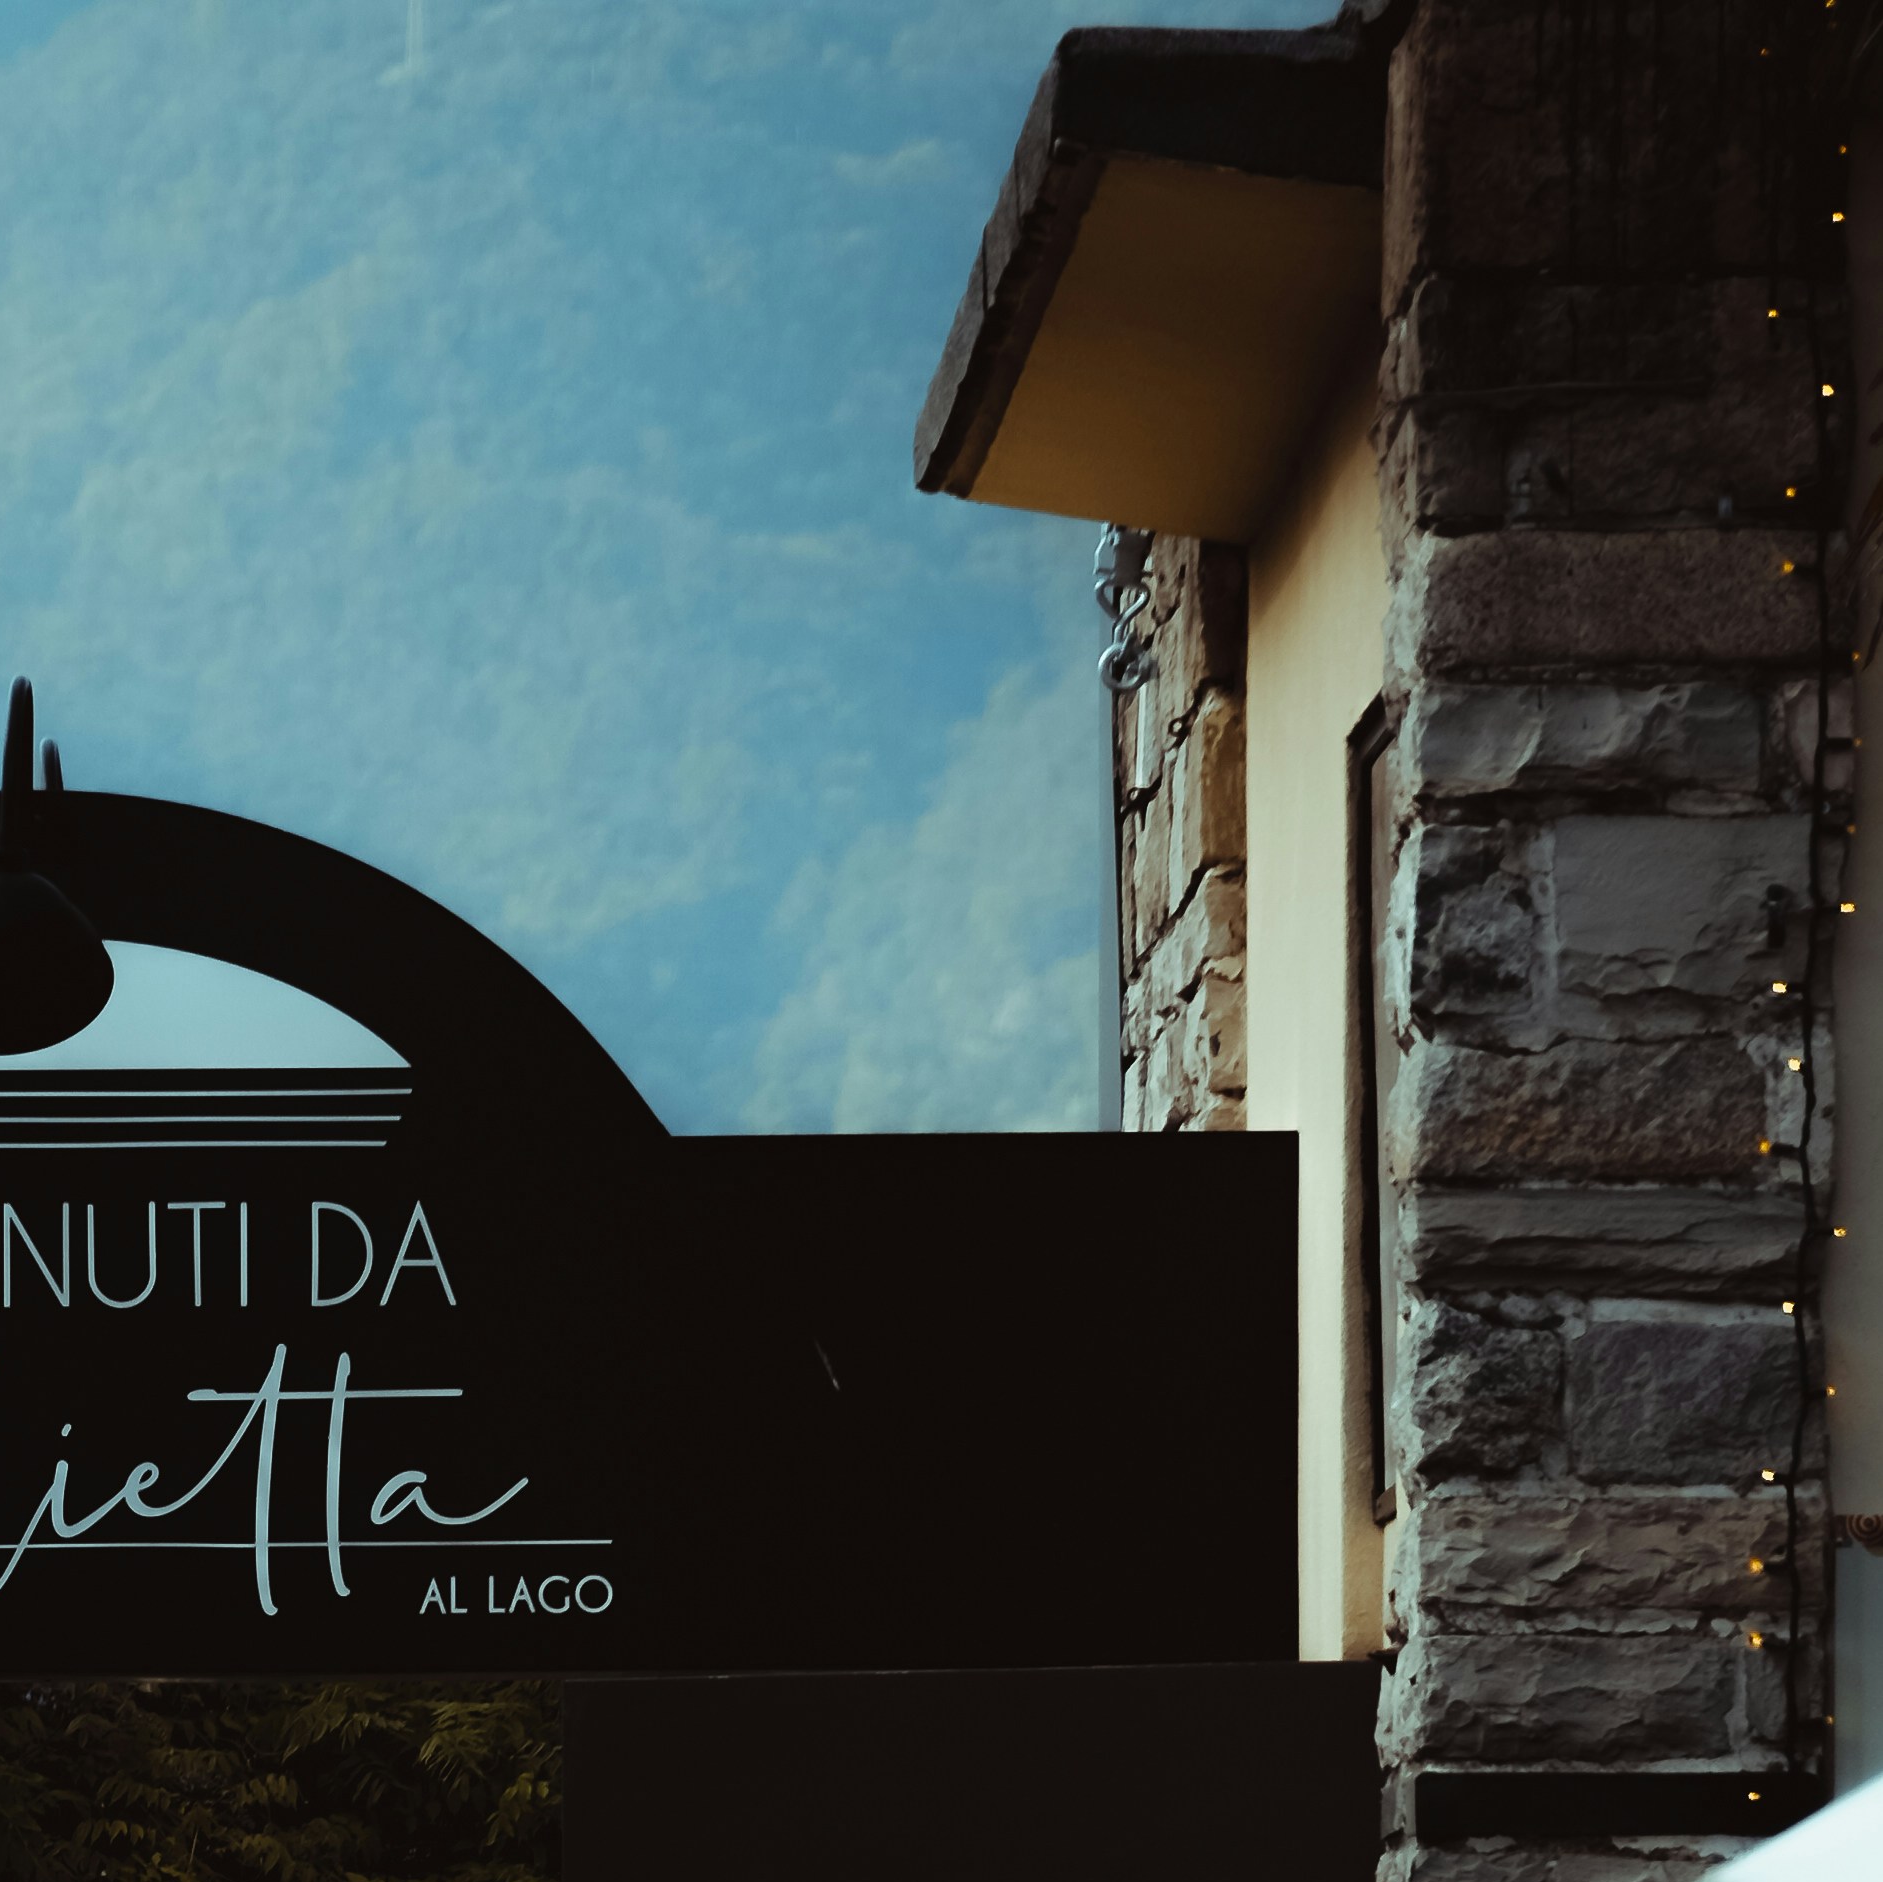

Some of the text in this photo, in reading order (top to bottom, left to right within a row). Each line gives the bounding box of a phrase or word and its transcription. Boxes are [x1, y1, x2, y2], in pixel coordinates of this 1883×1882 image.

[311, 1200, 457, 1307] DA
[419, 1575, 613, 1614] AL LAGO
